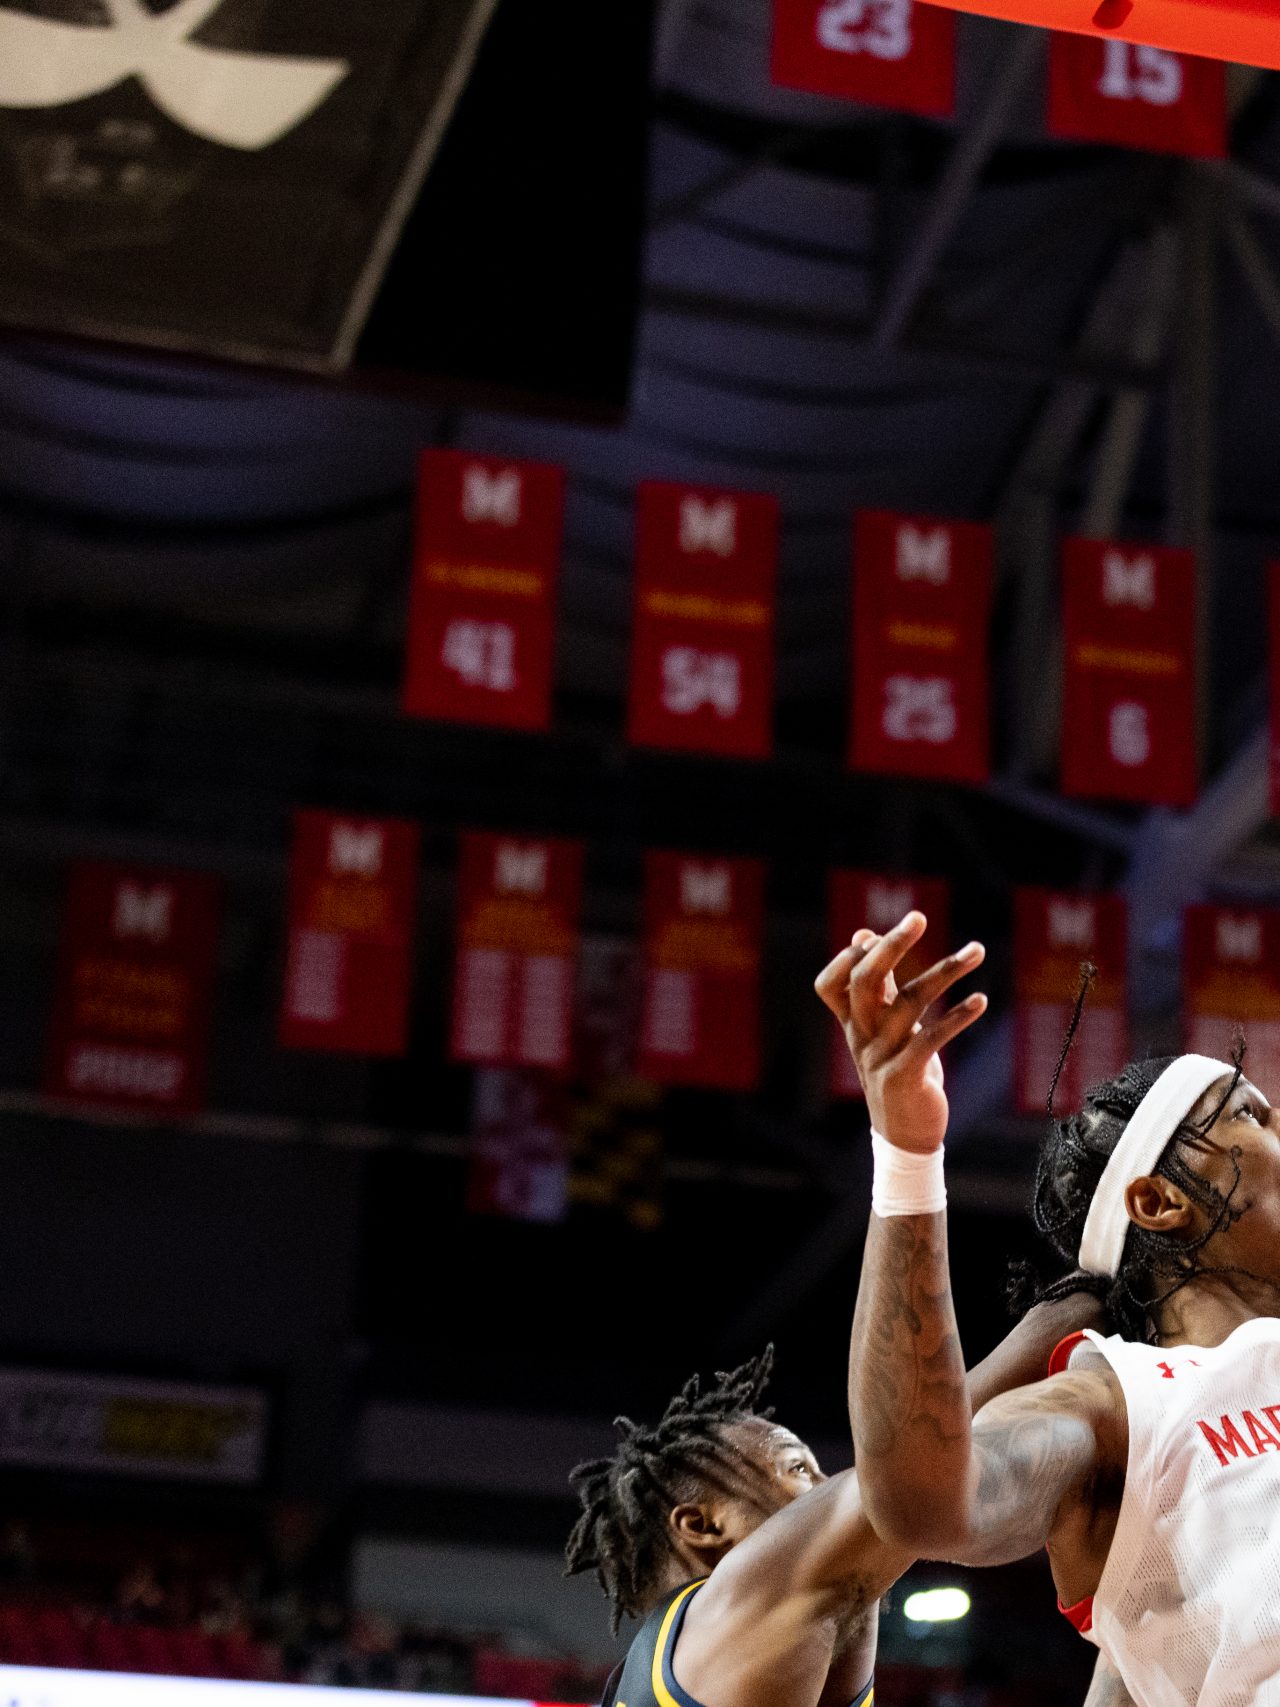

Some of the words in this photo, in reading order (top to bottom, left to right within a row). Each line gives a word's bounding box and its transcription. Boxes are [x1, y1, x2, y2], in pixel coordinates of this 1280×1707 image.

[817, 0, 912, 60] 23
[1096, 37, 1184, 106] 15
[462, 464, 521, 526] M
[680, 497, 736, 556] M
[896, 525, 950, 583] M
[1103, 551, 1155, 609] M
[661, 646, 740, 717] 54
[882, 675, 957, 744] 25
[1109, 701, 1150, 766] 6
[329, 824, 383, 876] M
[495, 844, 547, 895] M
[114, 883, 173, 938] M
[681, 865, 730, 914] M
[1048, 900, 1094, 948] M
[1216, 915, 1261, 962] M
